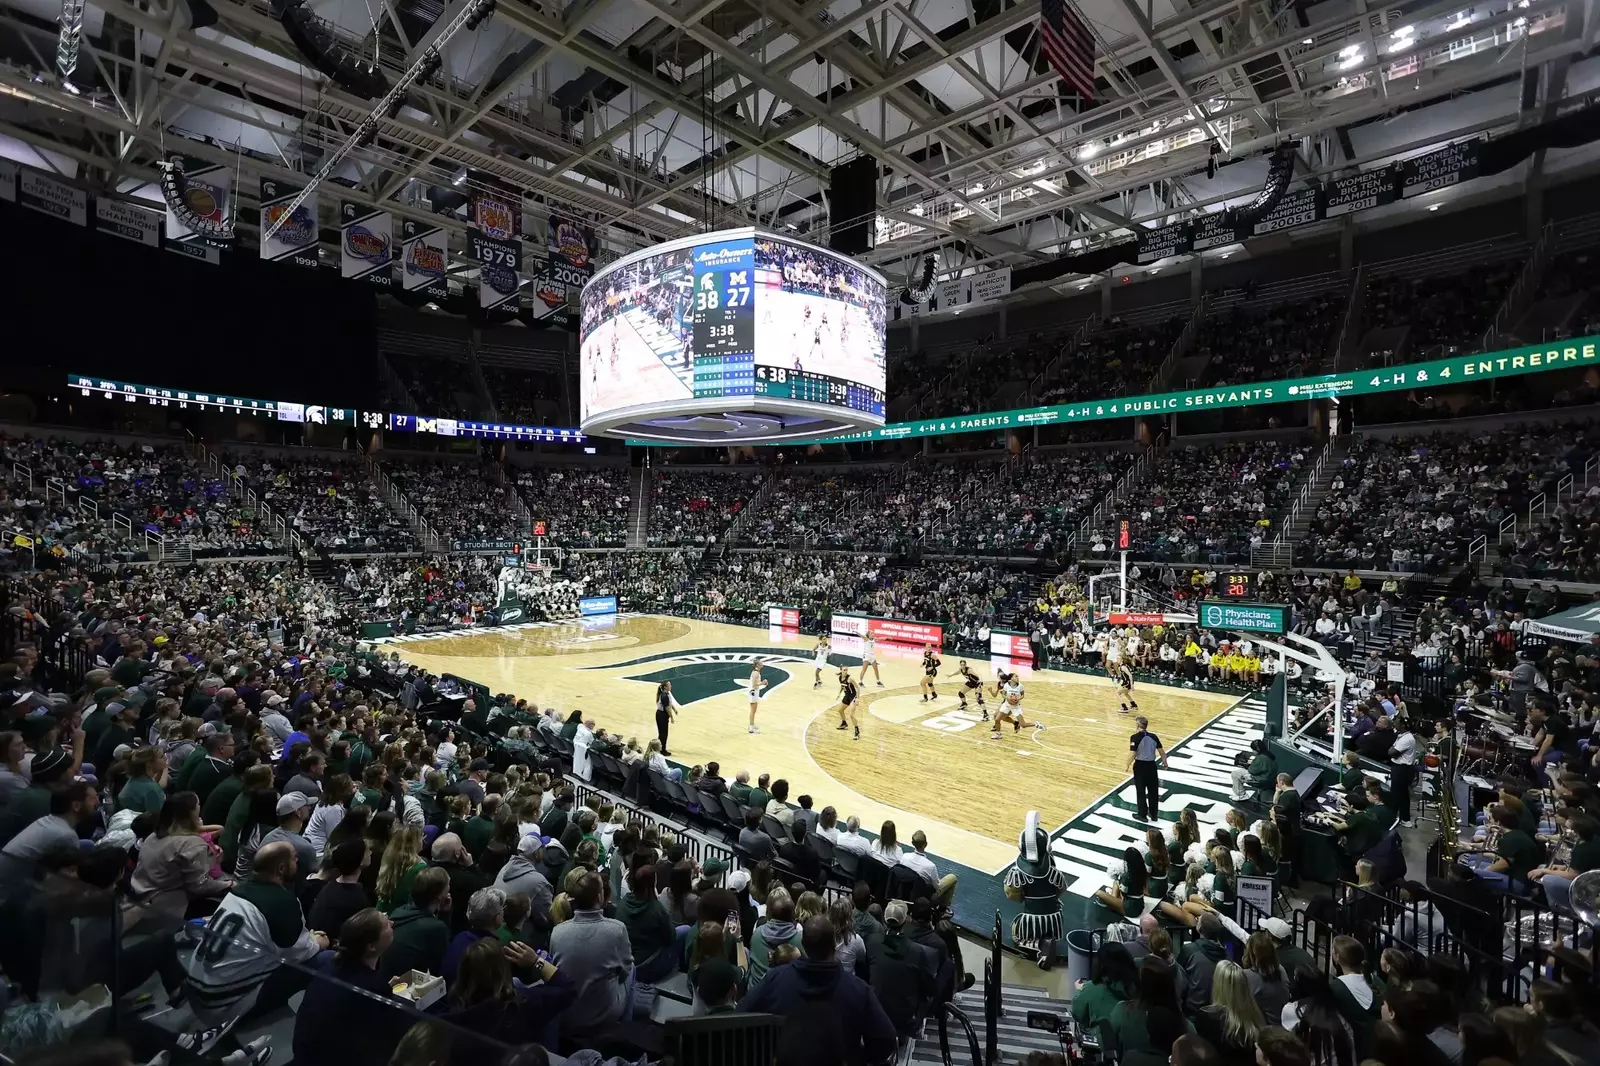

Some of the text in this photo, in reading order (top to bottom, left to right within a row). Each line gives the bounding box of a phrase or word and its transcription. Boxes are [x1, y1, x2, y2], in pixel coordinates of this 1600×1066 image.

[1414, 144, 1468, 166] WOMEN'S
[1405, 157, 1478, 185] CHAMPIONS
[1418, 154, 1463, 174] BIG TEN
[188, 180, 214, 192] NCAA
[1336, 170, 1386, 188] WOMEN'S
[1425, 174, 1454, 190] 2014
[1328, 184, 1393, 206] CHAMPIONS
[1340, 180, 1381, 196] BIG TEN
[110, 204, 146, 220] BIG TEN
[1348, 198, 1372, 211] 2011
[98, 208, 158, 232] CHAMPIONS
[1271, 215, 1302, 230] 2005
[117, 225, 140, 238] 1959
[1144, 224, 1182, 239] WOMEN'S
[1148, 232, 1178, 245] BIG TEN
[474, 238, 516, 255] CHAMPIONS
[1140, 236, 1187, 252] CHAMPIONS
[1208, 234, 1233, 246] 2005
[295, 256, 318, 267] 1999
[474, 246, 516, 267] 1979
[694, 248, 753, 262] Auto-Owners
[705, 257, 741, 266] INSURANCE
[1152, 248, 1172, 260] 1997
[554, 261, 590, 276] CHAMPIONS
[370, 274, 391, 285] 2001
[554, 268, 590, 286] 2000
[730, 271, 747, 286] M
[428, 287, 447, 296] 2005
[537, 280, 566, 298] FOUR
[697, 287, 750, 311] 38 27
[948, 298, 957, 306] 24
[502, 304, 519, 313] 2009
[910, 306, 919, 314] 32
[710, 324, 734, 337] 3:38
[1370, 344, 1596, 386] 4-H & 4 ENTREPRE
[770, 367, 786, 384] 38
[830, 383, 846, 396] 3:38
[1314, 380, 1353, 389] EXTENSION
[874, 390, 881, 402] 27
[1068, 388, 1273, 418] 4-H & 4 PUBLIC SERVANTS
[332, 409, 344, 420] 38
[363, 412, 383, 424] 3:38
[396, 415, 408, 426] 27
[418, 418, 437, 432] M
[919, 424, 936, 433] 4-H
[940, 423, 946, 431] &
[960, 416, 1009, 428] PARENTS
[1229, 585, 1244, 595] 20
[1226, 609, 1270, 620] Physicians
[833, 618, 860, 633] meijer
[1226, 619, 1254, 627] Health
